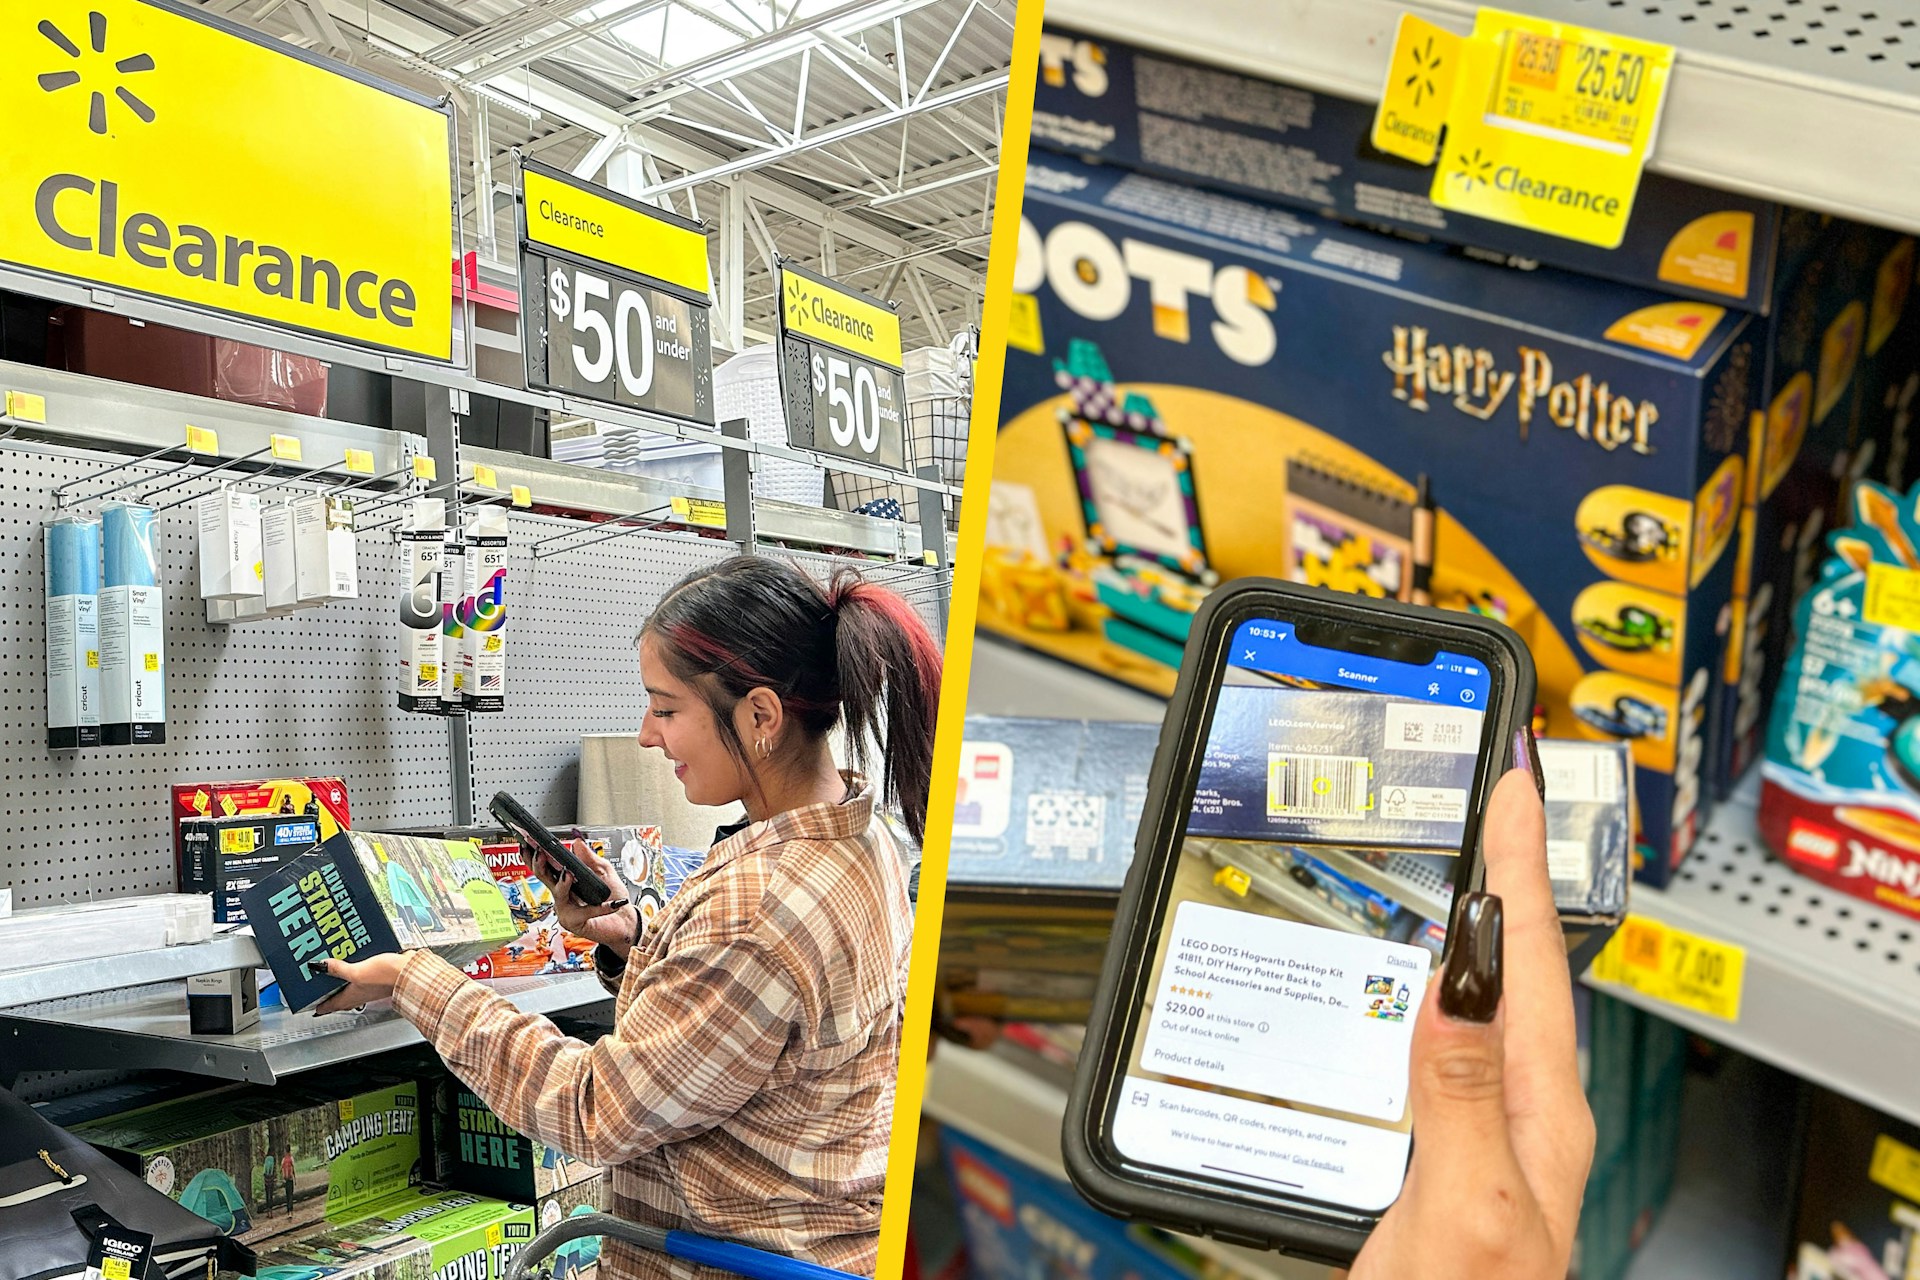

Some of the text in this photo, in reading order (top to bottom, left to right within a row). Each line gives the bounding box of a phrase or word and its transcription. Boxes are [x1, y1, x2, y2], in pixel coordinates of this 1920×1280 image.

[1494, 165, 1620, 217] Clearance
[539, 199, 604, 239] Clearance
[34, 173, 417, 328] Clearance
[655, 315, 677, 333] and
[811, 297, 874, 343] Clearance
[656, 339, 691, 361] under
[877, 385, 891, 401] and
[1382, 325, 1659, 455] Harry Potter
[878, 406, 900, 423] under
[1249, 626, 1276, 639] 10:53
[1338, 668, 1379, 684] Scanner
[1450, 664, 1463, 674] LTE
[1268, 718, 1346, 731] LEGO.com/service
[1268, 742, 1292, 752] Item:
[299, 870, 357, 960] STARTS
[320, 862, 372, 949] ADVENTURE
[1177, 952, 1322, 988] 41811, DIY Harry Potter Back to
[1181, 938, 1343, 978] LEGO DOTS Hogwarts Desktop Kit
[1386, 954, 1418, 970] Dismiss
[1174, 965, 1206, 979] School
[1207, 973, 1262, 991] Accessories
[1263, 985, 1282, 995] and
[1283, 987, 1326, 1005] Supplies,
[1165, 1000, 1255, 1029] $29.00 at this store
[1160, 1019, 1240, 1043] Out of stock online
[1154, 1048, 1225, 1072] Product details
[325, 1109, 415, 1160] CAMPING TENT
[1159, 1099, 1347, 1146] Scan barcodes, QR codes, receipts, and more
[460, 1131, 521, 1170] HERE
[1171, 1129, 1190, 1140] We'd
[1190, 1133, 1206, 1143] love
[1207, 1137, 1216, 1146] to
[379, 1195, 481, 1233] CAMPING TENT
[103, 1237, 142, 1254] IGLOO
[507, 1224, 528, 1238] YOUTH
[429, 1249, 488, 1280] MPING
